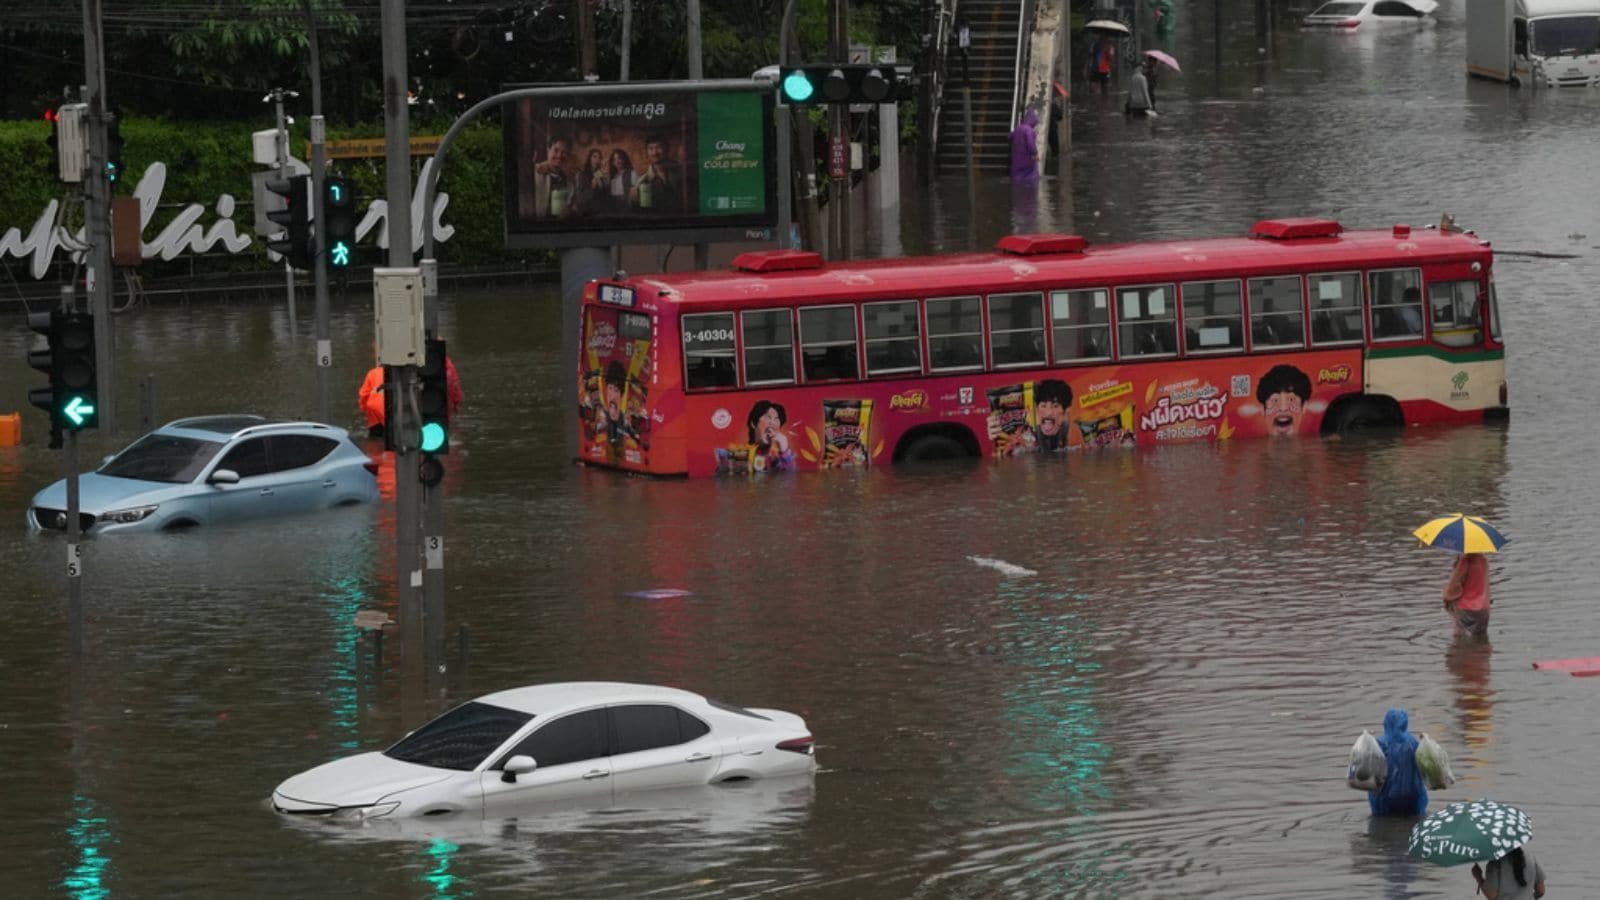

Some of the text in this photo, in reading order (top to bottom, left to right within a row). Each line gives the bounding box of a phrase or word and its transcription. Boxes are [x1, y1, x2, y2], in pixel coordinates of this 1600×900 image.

[715, 140, 746, 151] Chang
[322, 355, 329, 366] 6
[429, 536, 439, 550] 3
[1421, 840, 1481, 859] S-Pure
